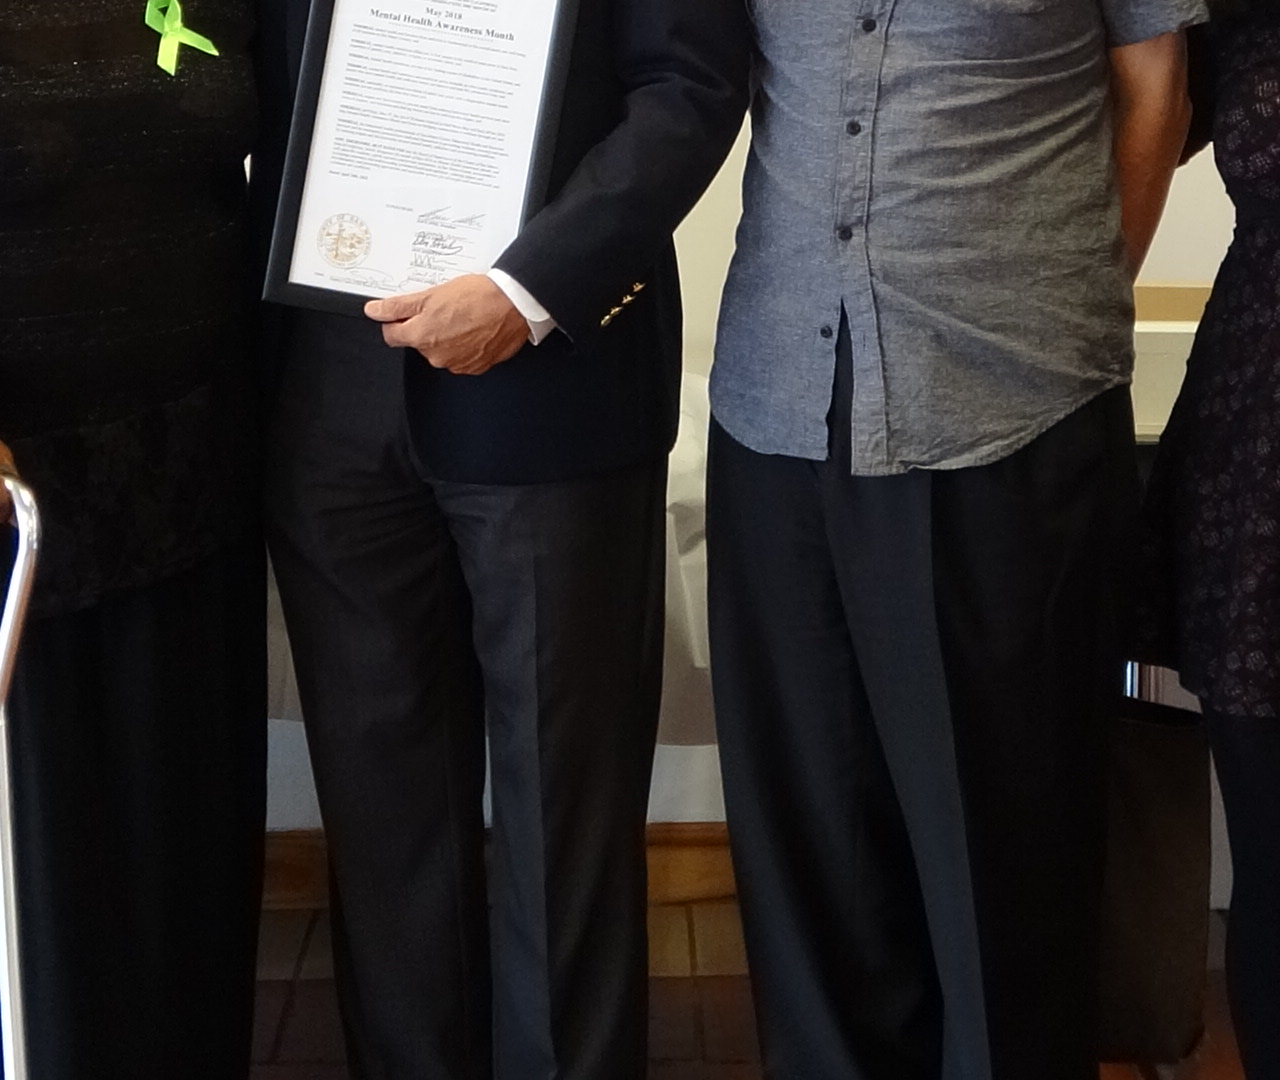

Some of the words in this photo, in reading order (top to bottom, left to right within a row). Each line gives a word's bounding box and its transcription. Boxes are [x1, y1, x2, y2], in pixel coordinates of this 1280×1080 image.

[425, 7, 442, 19] May
[370, 8, 401, 22] Mental
[403, 14, 433, 27] Health
[435, 21, 484, 36] Awareness
[485, 29, 516, 42] Month
